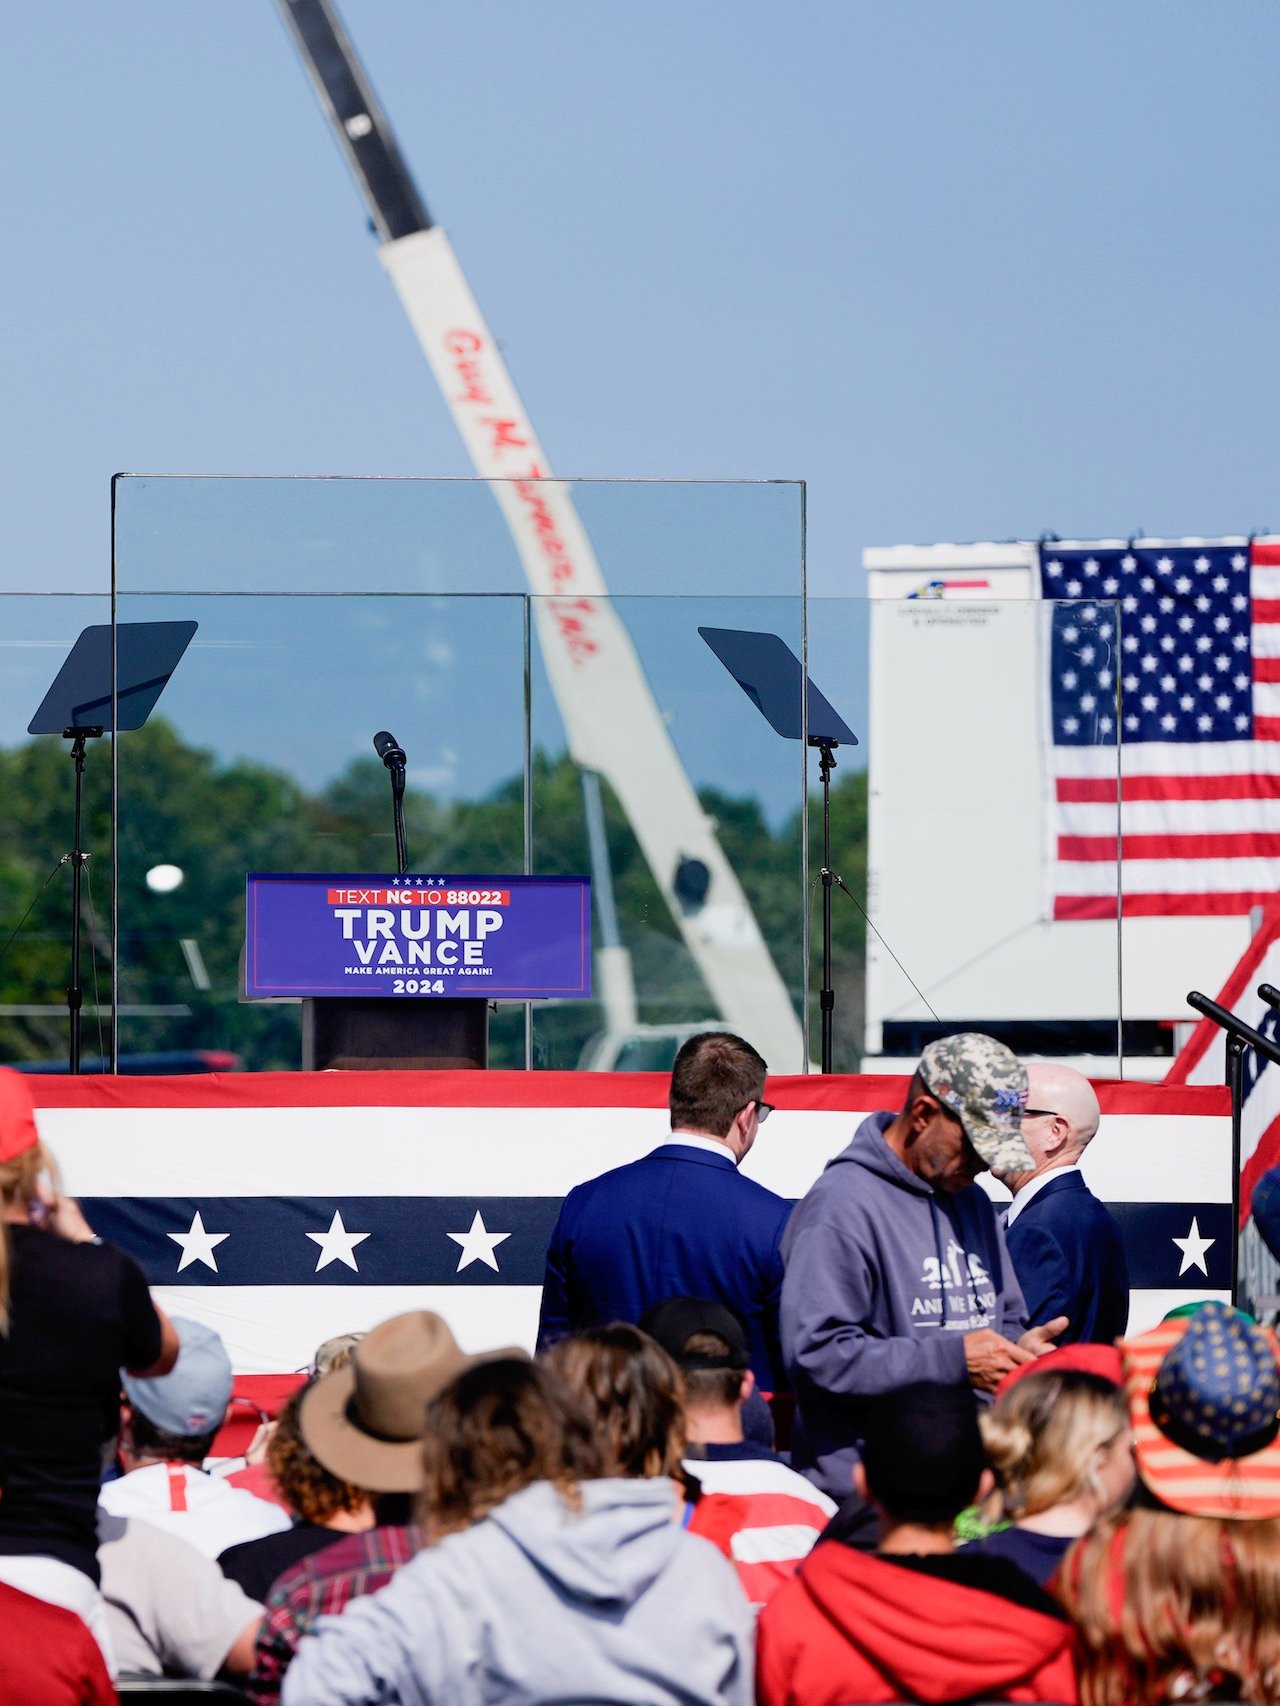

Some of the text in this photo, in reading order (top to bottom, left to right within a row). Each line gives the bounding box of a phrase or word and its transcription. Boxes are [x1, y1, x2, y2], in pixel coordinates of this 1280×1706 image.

[444, 326, 494, 405] Guy
[336, 890, 502, 905] TEXT NC TO 88022
[334, 909, 504, 940] TRUMP
[352, 940, 484, 965] VANCE
[344, 966, 493, 976] MAKE AMERICA GREAT AGAIN!
[392, 979, 445, 994] 2024
